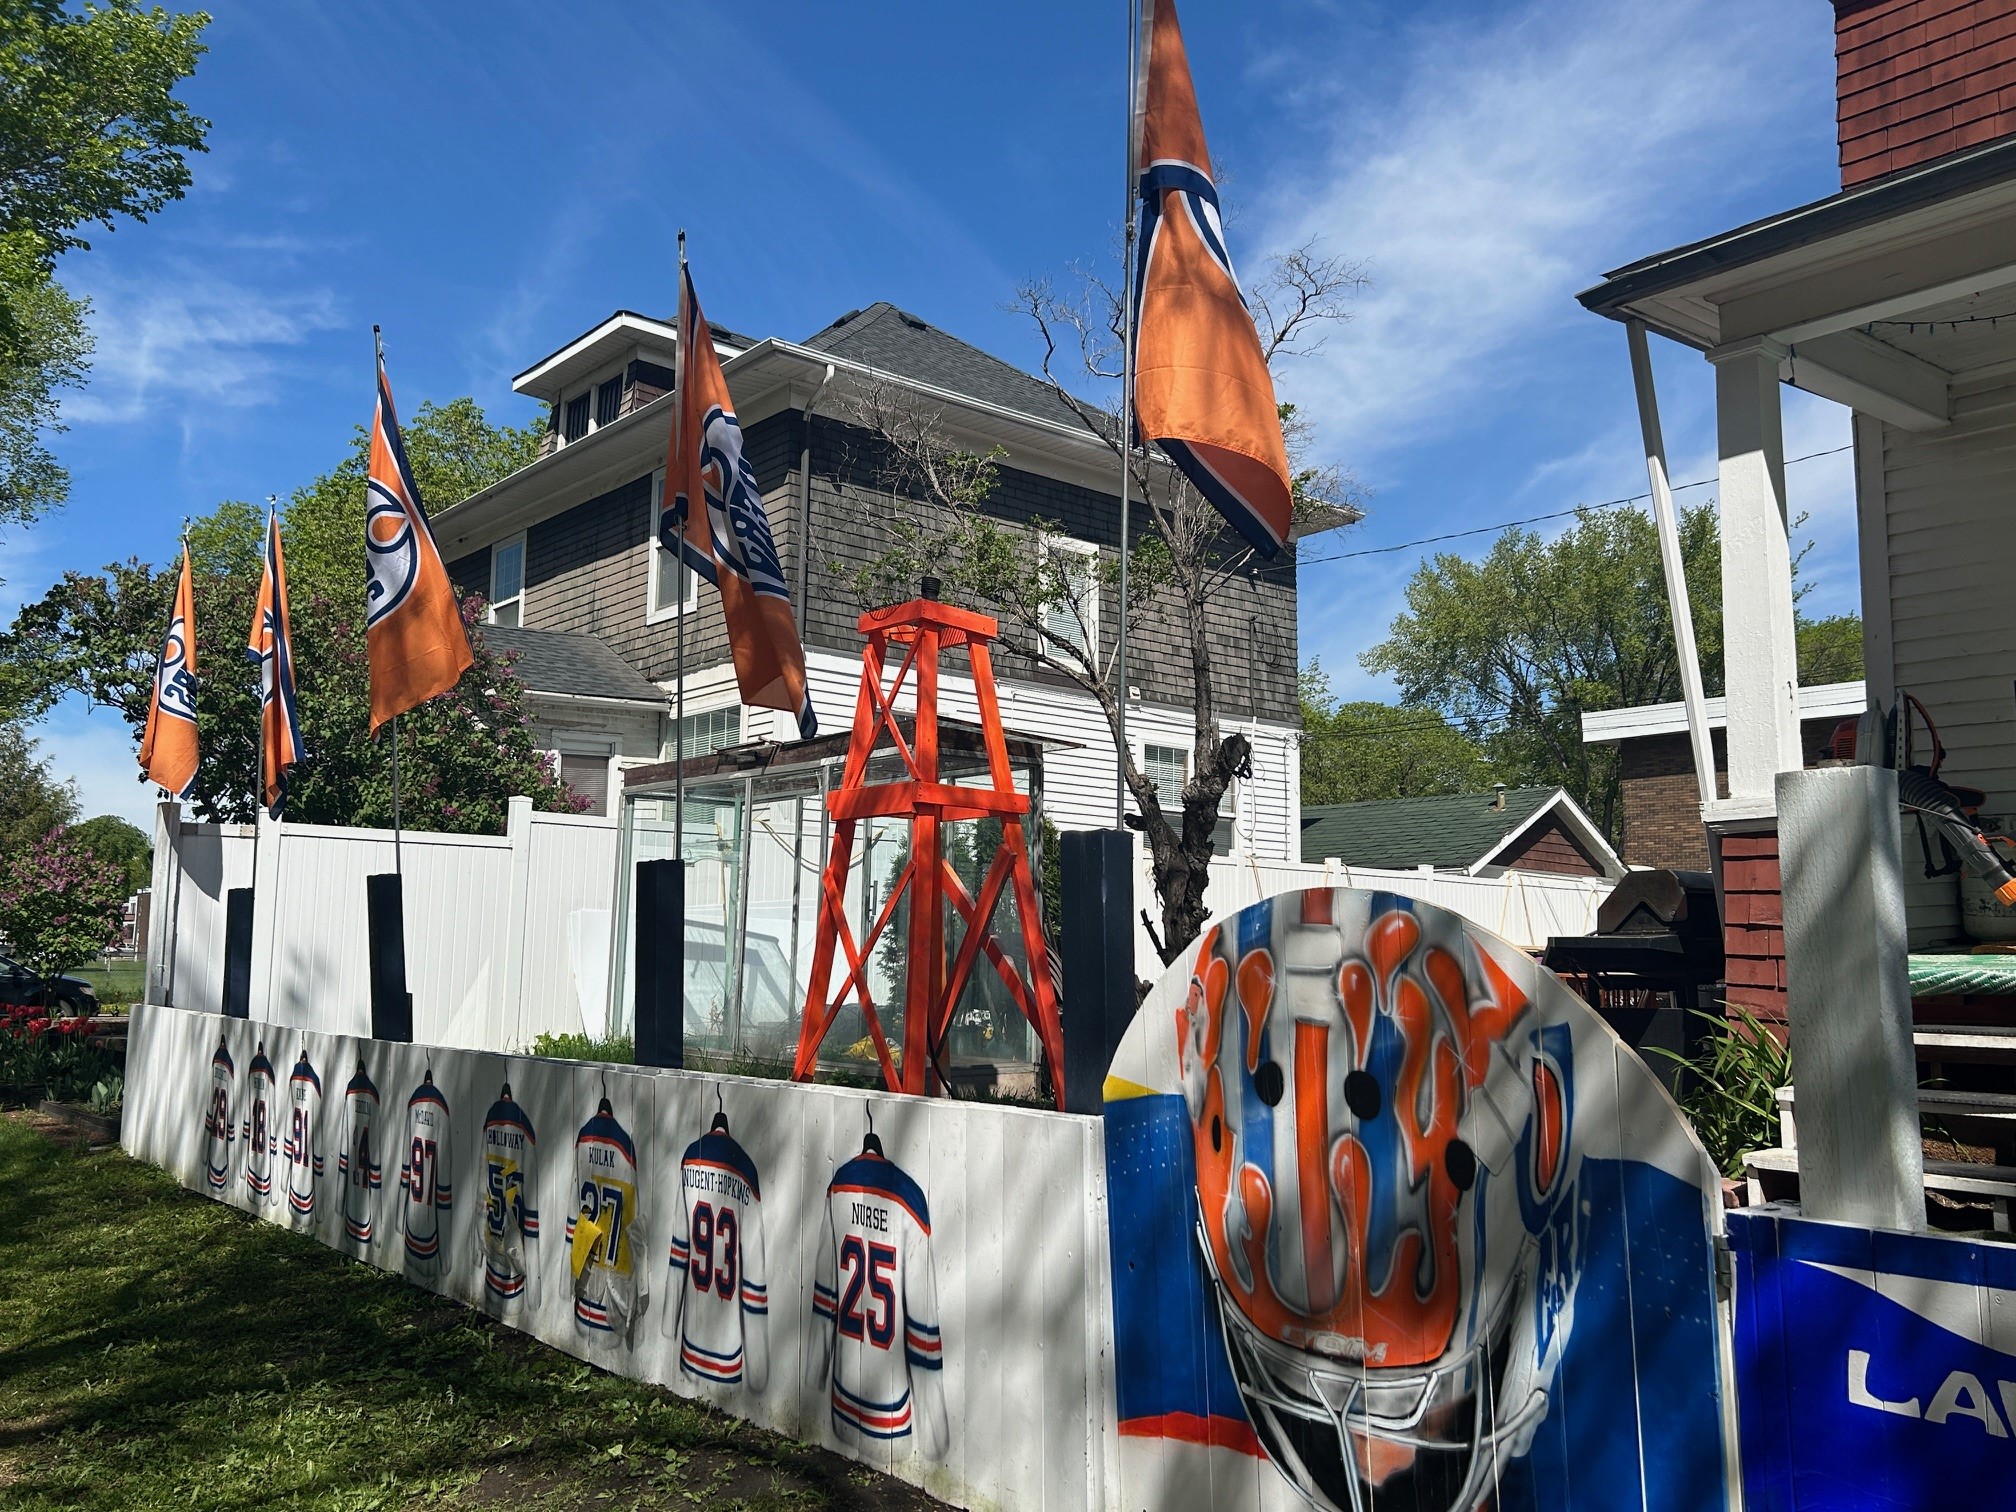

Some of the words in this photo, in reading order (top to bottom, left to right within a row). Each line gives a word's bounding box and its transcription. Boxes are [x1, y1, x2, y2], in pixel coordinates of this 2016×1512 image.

[251, 1098, 266, 1155] 18
[293, 1107, 309, 1168] 91
[487, 1129, 525, 1151] HOLLOWAY
[411, 1136, 438, 1207] 97
[588, 1146, 615, 1168] KULAK
[682, 1166, 751, 1207] NUGENT-HOPKINS
[850, 1202, 889, 1233] NURSE
[690, 1200, 738, 1301] 93
[838, 1234, 897, 1350] 25
[1848, 1349, 2016, 1440] LA
